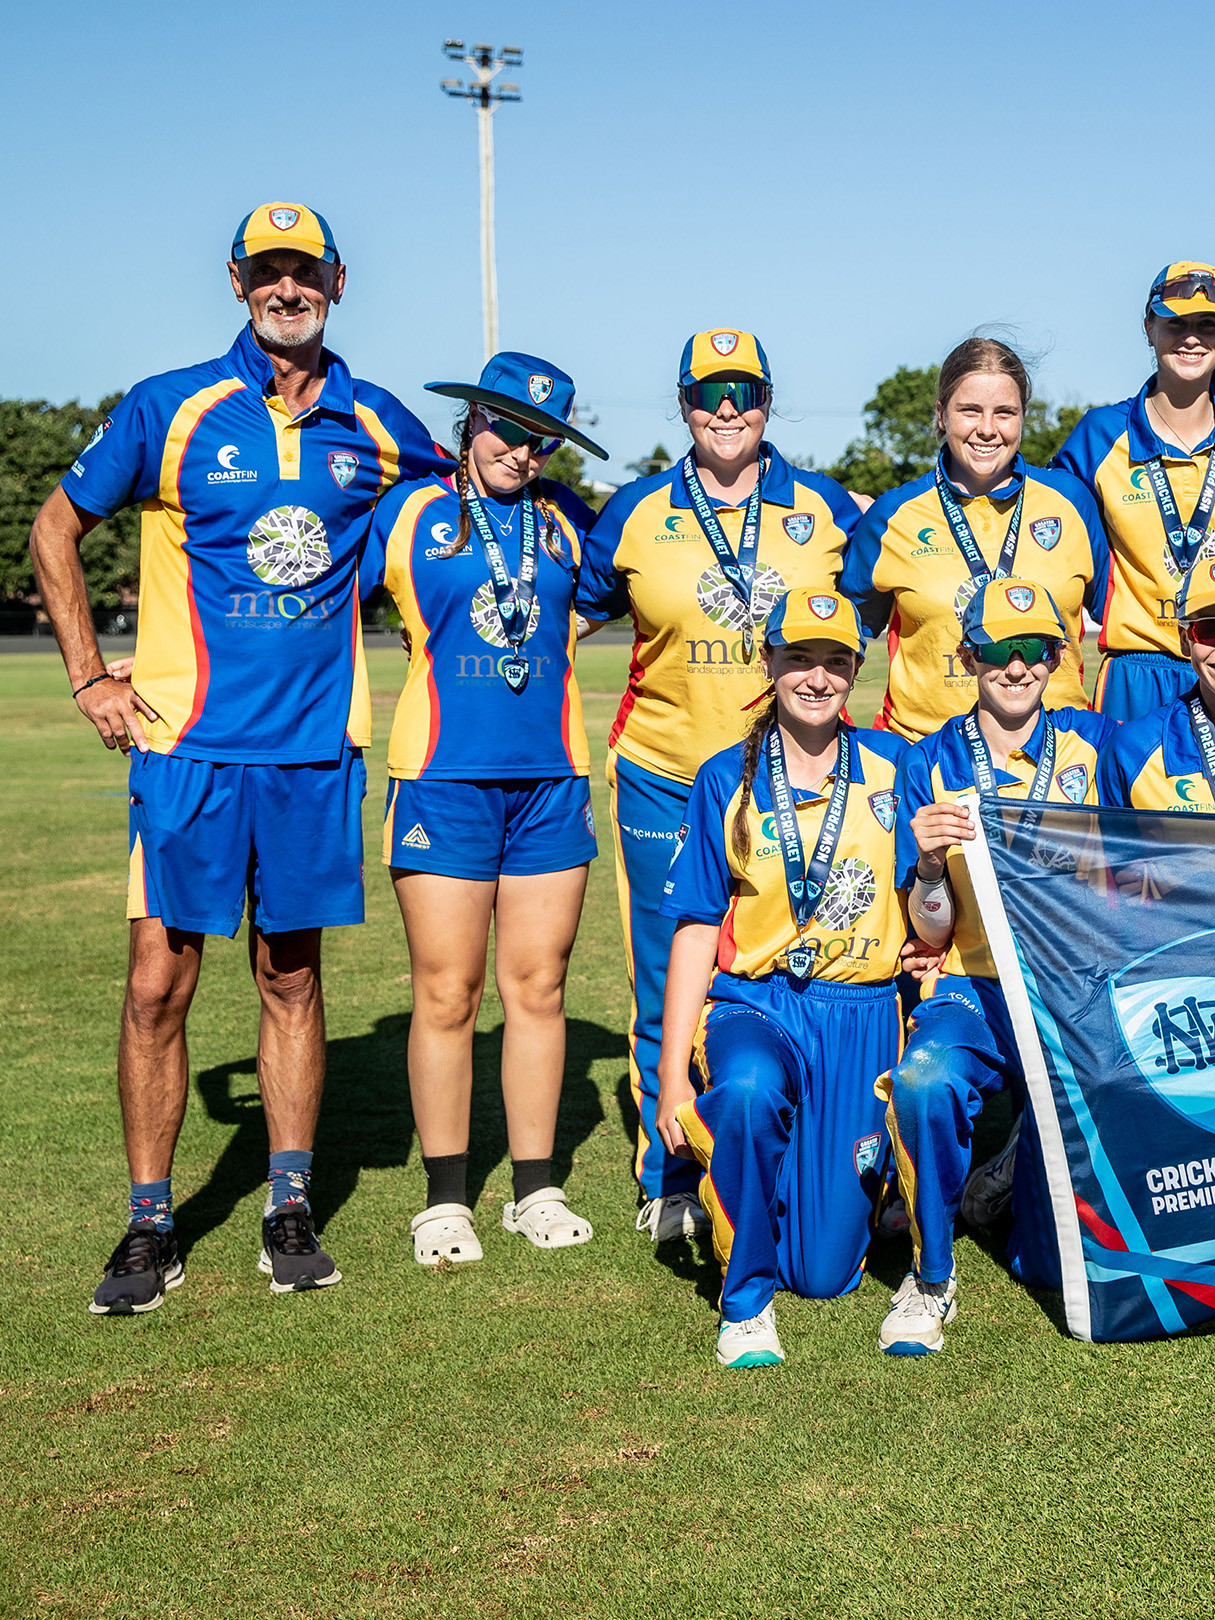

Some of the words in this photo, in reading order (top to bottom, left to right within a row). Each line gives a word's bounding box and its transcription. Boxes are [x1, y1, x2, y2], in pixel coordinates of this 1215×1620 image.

[207, 470, 258, 481] COASTFIN
[683, 456, 694, 477] NSW
[687, 477, 711, 519] PREMIER
[1152, 469, 1175, 516] CRICKET
[1199, 485, 1214, 513] NSW
[523, 514, 534, 555] PREMIER
[704, 518, 730, 556] CRICKET
[743, 522, 756, 548] NSW
[939, 483, 963, 524] PREMIER
[955, 523, 980, 563] CRICKET
[468, 500, 489, 546] PREMIER
[486, 541, 509, 587] CRICKET
[1003, 530, 1016, 557] NSW
[520, 555, 534, 582] NSW
[965, 715, 980, 740] NSW
[1190, 697, 1206, 724] NSW
[769, 731, 781, 758] NSW
[971, 740, 992, 791] PREMIER
[1032, 759, 1052, 801] REMIER
[771, 758, 788, 813] PREMIER
[816, 832, 833, 863] NSW
[826, 778, 846, 833] PREMIER
[840, 732, 849, 778] CRICKET
[779, 811, 801, 863] CRICKET
